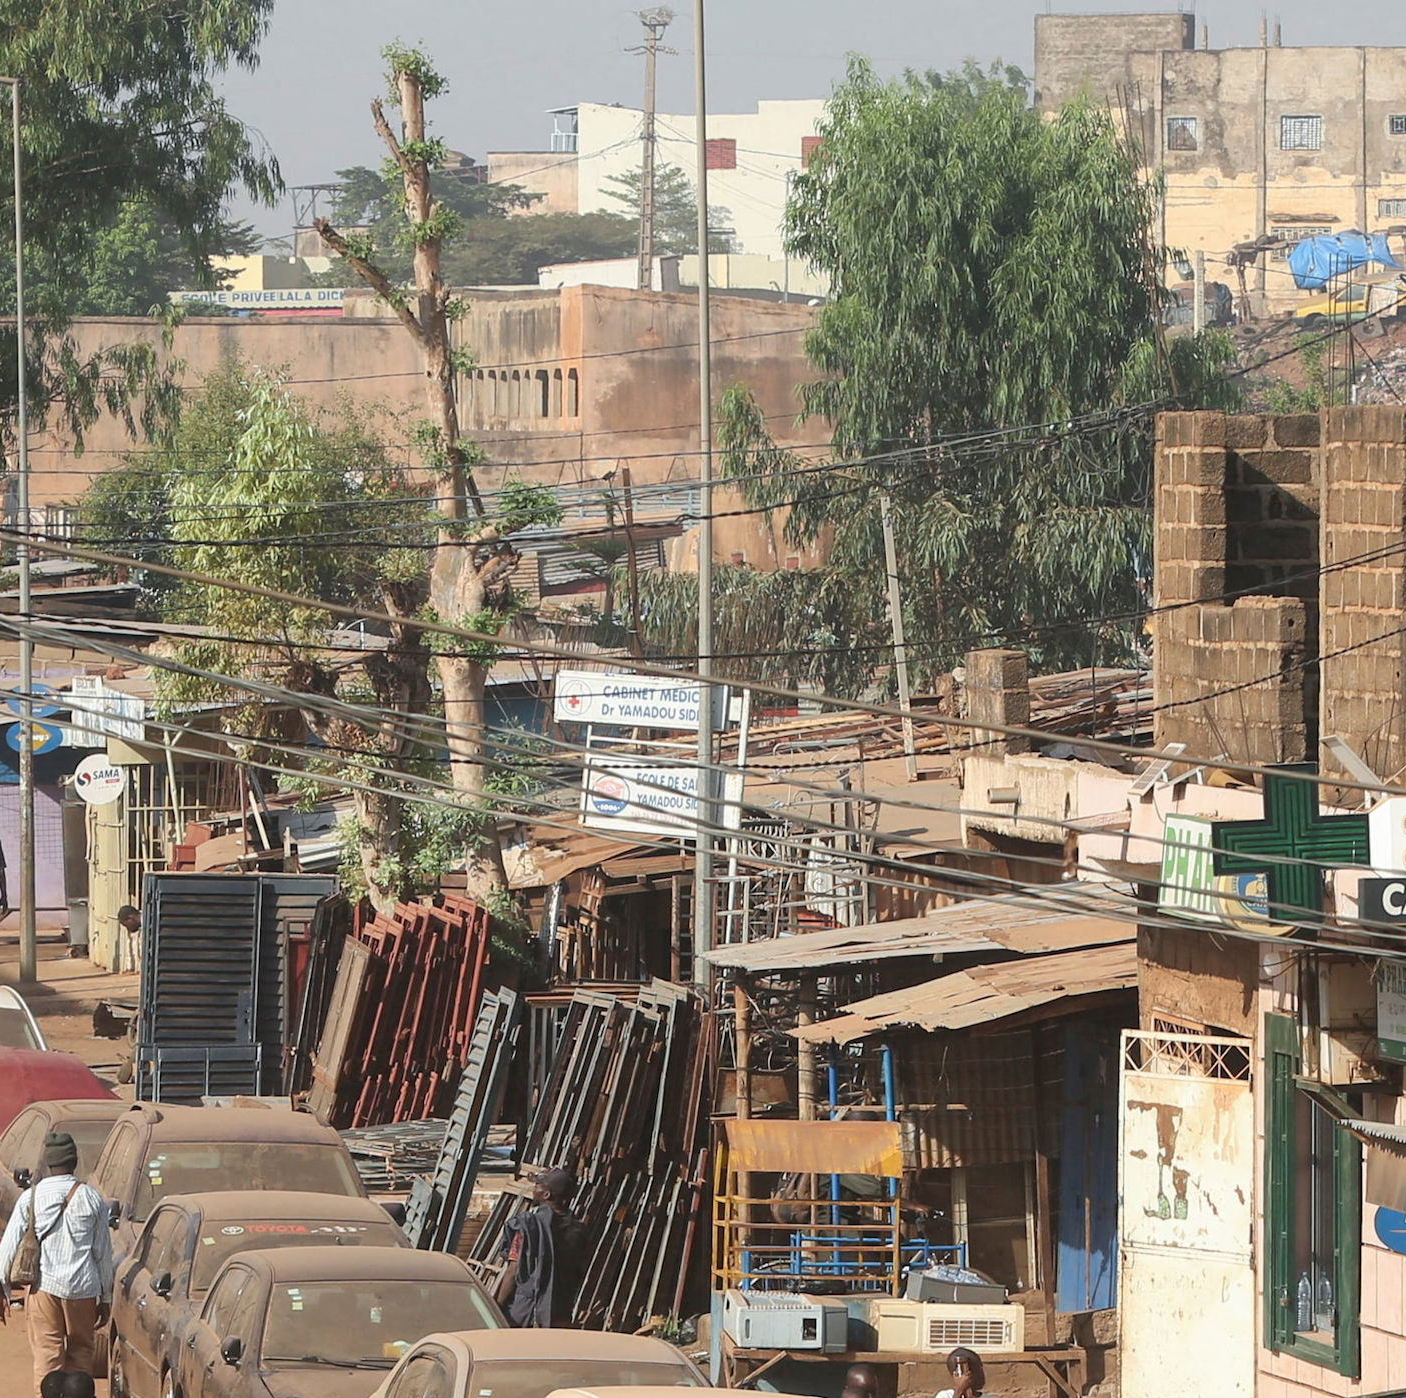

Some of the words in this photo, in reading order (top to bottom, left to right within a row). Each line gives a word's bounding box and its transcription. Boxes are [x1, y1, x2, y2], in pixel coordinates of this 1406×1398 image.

[232, 292, 276, 303] PRIVEE
[280, 291, 311, 302] LALA
[603, 685, 655, 700] CABINET
[601, 703, 614, 716] Dr
[619, 704, 676, 720] YAMADOU
[678, 709, 700, 721] SID
[93, 769, 120, 780] SAMA
[637, 772, 666, 786] ECOLE
[668, 775, 680, 788] DE
[682, 777, 698, 791] SA
[637, 793, 683, 808] YAMADOU
